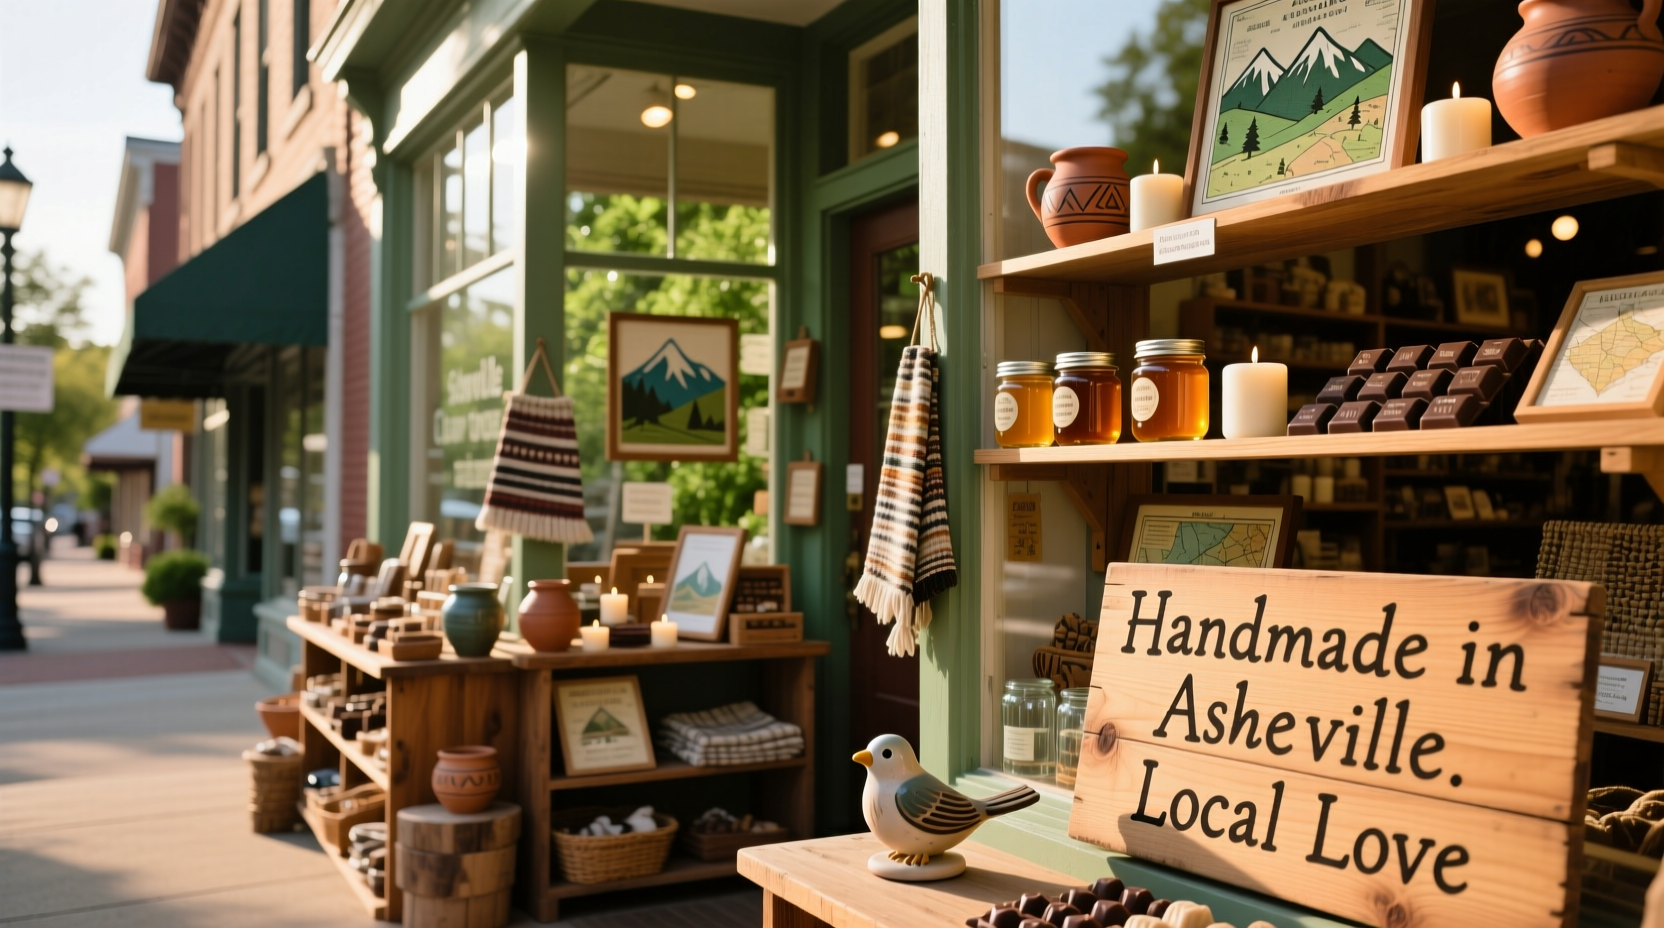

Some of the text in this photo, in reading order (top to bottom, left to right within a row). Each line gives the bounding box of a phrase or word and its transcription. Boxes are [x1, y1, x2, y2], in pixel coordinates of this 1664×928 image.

[1121, 590, 1527, 692] Handmade in
[1152, 673, 1463, 788] Asheville.
[1130, 759, 1470, 895] Local Love
